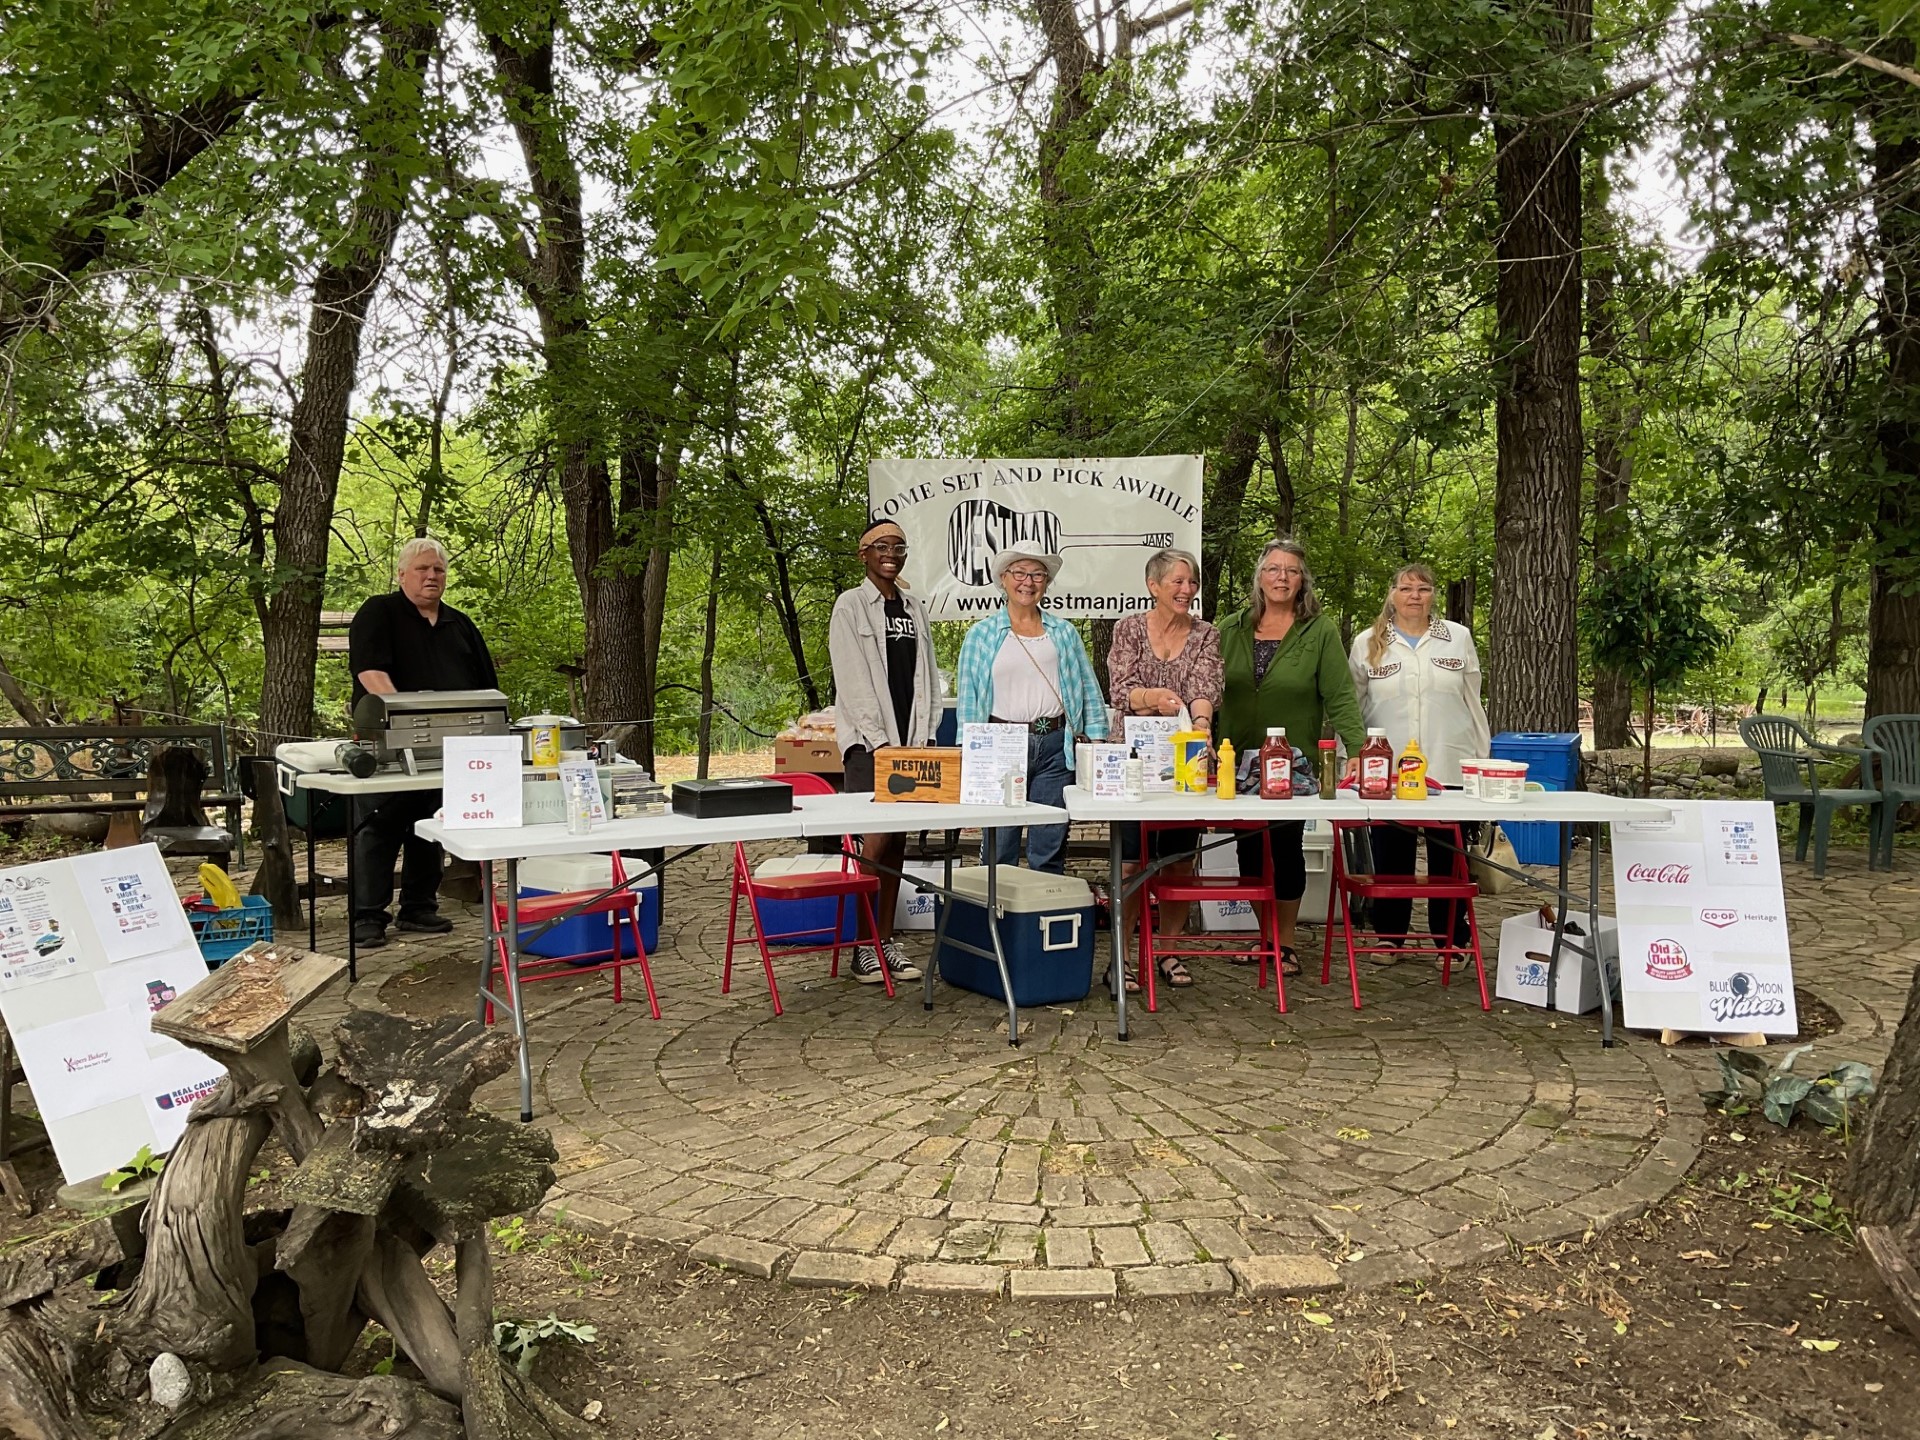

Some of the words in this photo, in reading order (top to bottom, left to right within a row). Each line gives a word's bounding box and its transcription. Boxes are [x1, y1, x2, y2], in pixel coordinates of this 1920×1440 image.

[871, 482, 935, 521] COME
[942, 471, 983, 494] SET
[992, 467, 1042, 486] AND
[1053, 467, 1104, 487] PICK
[1112, 474, 1199, 523] AWHILE
[949, 500, 1058, 586] WESTMAN
[1142, 533, 1173, 549] JAMS
[885, 616, 915, 634] LISTE
[468, 760, 493, 771] CDs
[892, 760, 941, 772] WESTMAN
[915, 771, 942, 782] JAMS
[471, 793, 486, 803] $1
[463, 809, 494, 820] each
[122, 897, 139, 906] CHIPS
[1744, 913, 1778, 922] Heritage
[1650, 943, 1670, 954] Old
[1652, 954, 1684, 965] Dutch
[1710, 982, 1730, 993] BLUE
[1758, 983, 1784, 994] MOON
[1710, 995, 1786, 1022] Water
[172, 1086, 193, 1098] REAL
